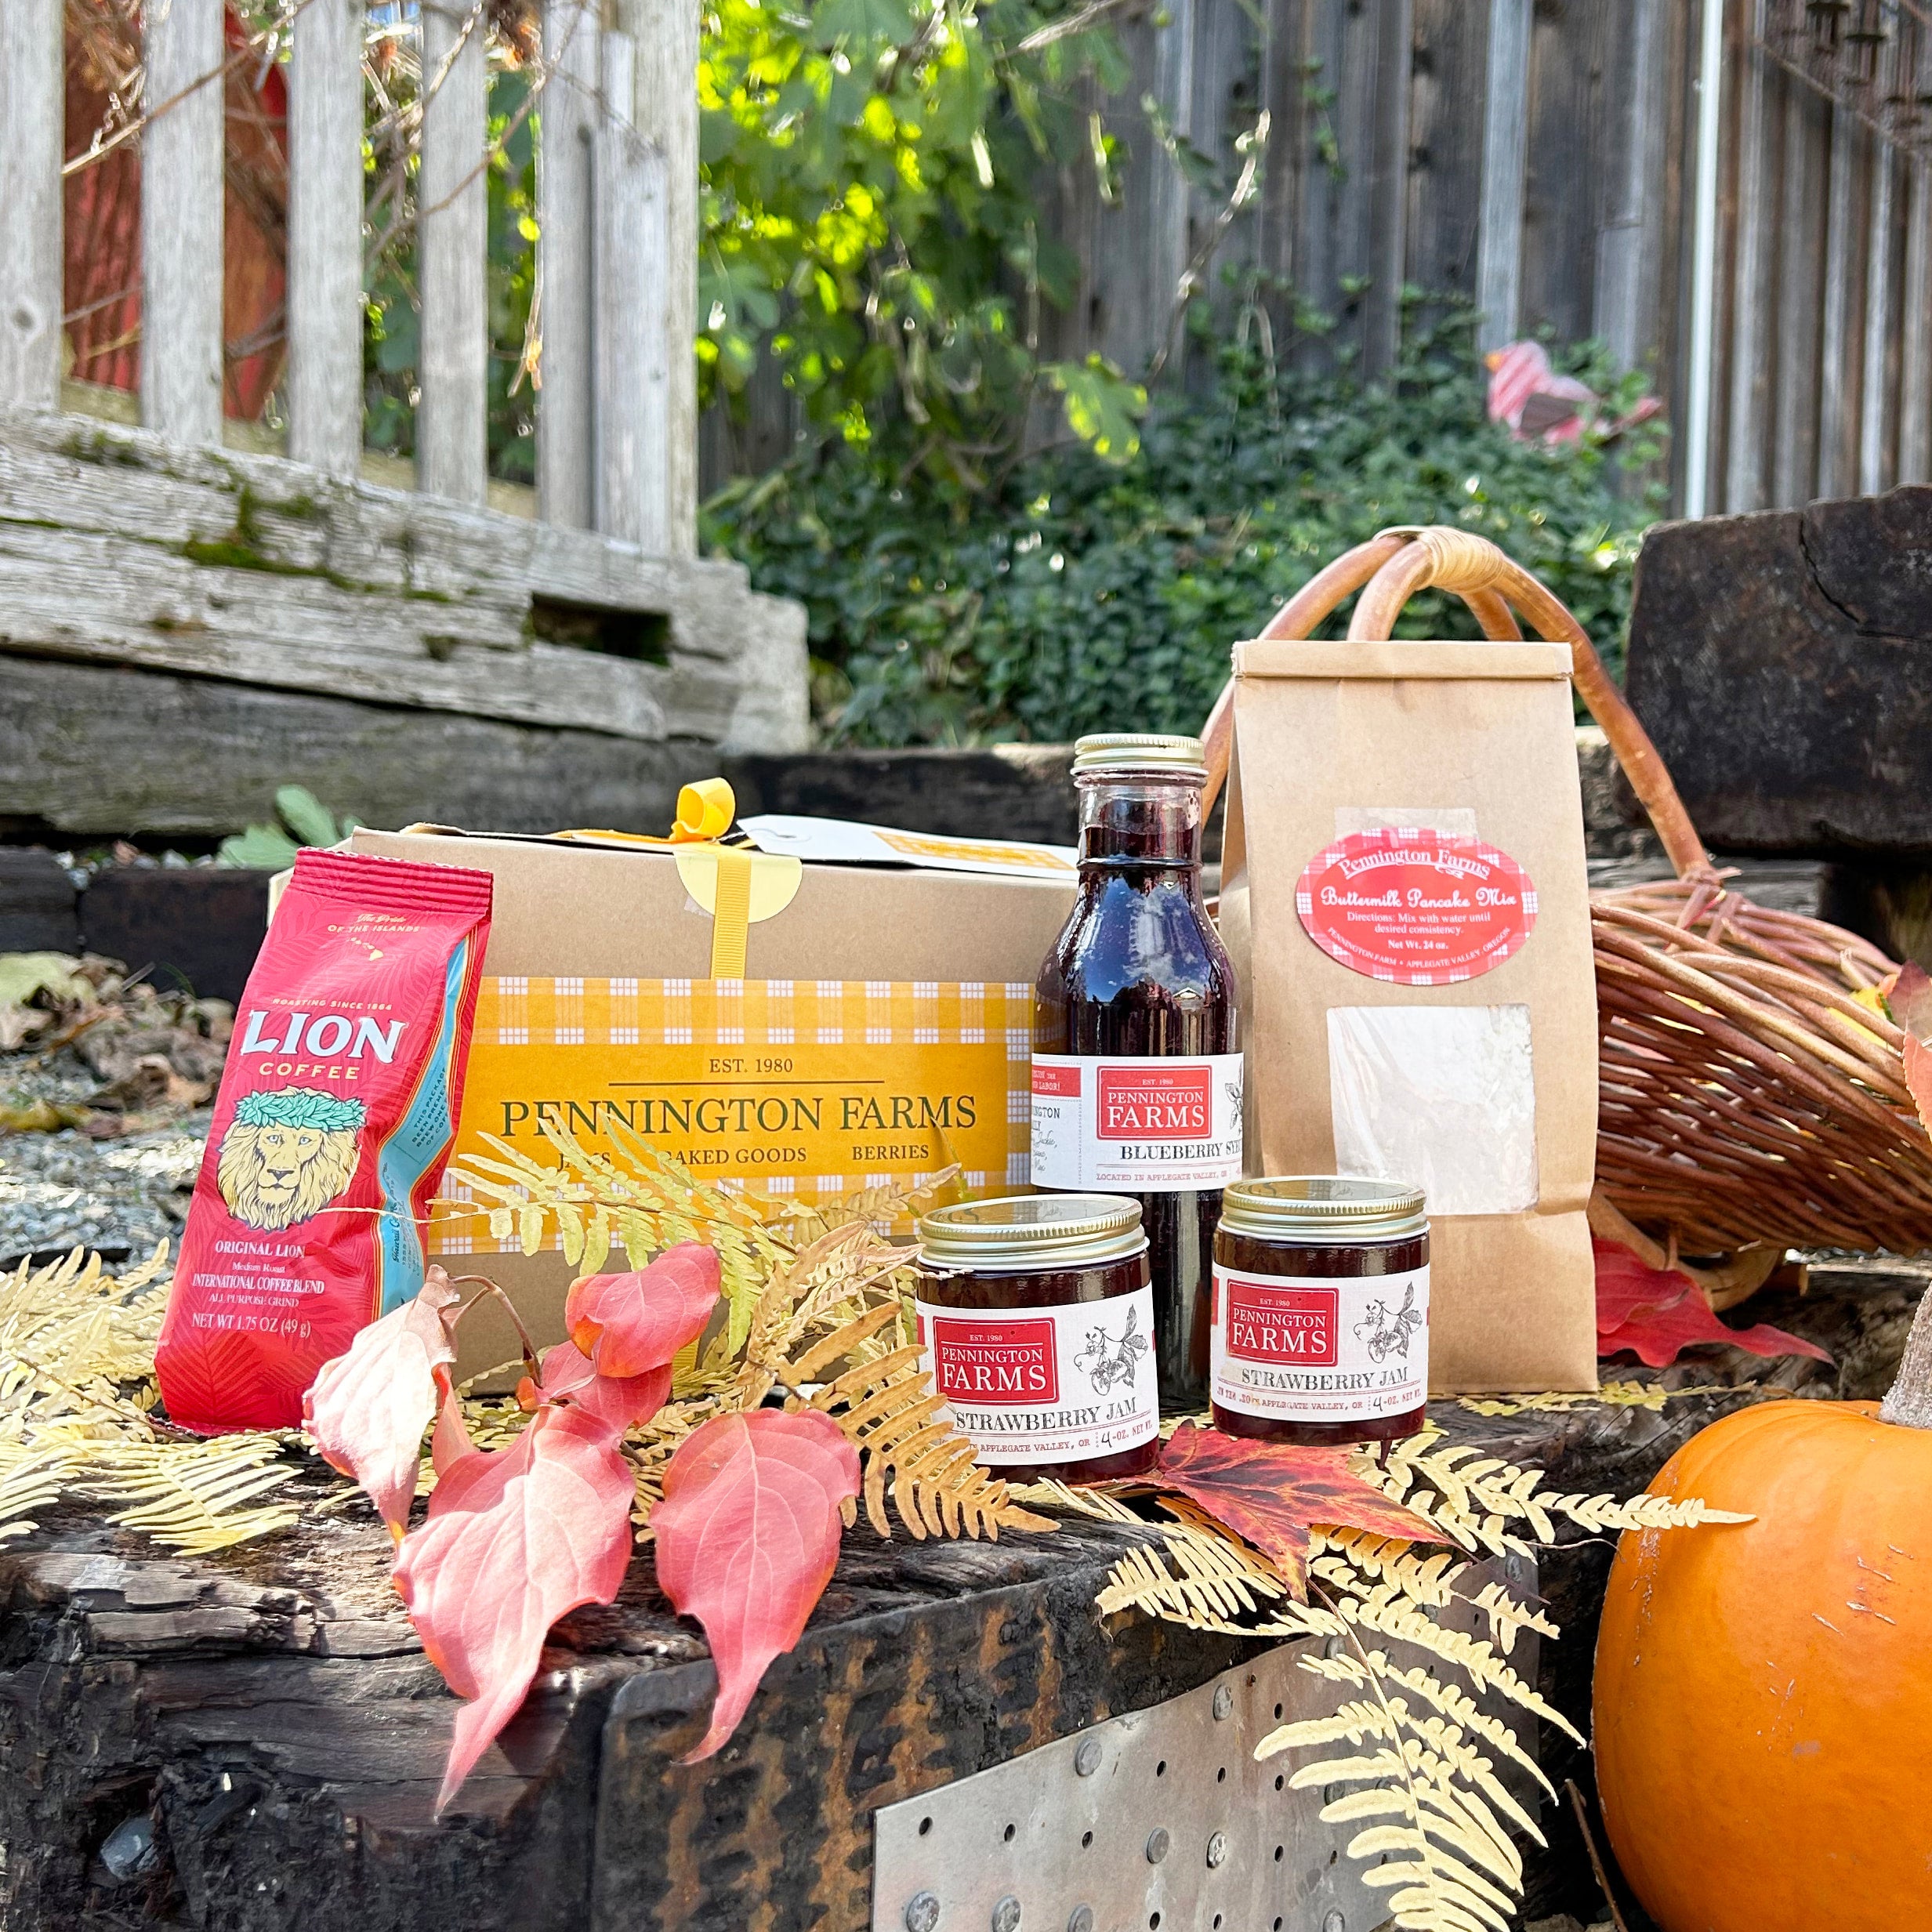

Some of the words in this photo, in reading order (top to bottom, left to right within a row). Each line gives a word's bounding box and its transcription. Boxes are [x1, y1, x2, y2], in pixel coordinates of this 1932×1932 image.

[1337, 848, 1431, 875] Pennington
[1437, 850, 1491, 877] Farms
[1321, 886, 1402, 908] Buttermilk
[1407, 887, 1470, 908] Pancake
[1475, 886, 1517, 907] Mix
[357, 913, 376, 923] The
[376, 915, 407, 924] Pride
[1347, 911, 1395, 922] Directions:
[1398, 912, 1416, 923] Mix
[1419, 912, 1439, 923] with
[1442, 914, 1466, 923] water
[1470, 911, 1491, 923] until
[328, 924, 344, 933] OF
[348, 925, 369, 933] THE
[1374, 923, 1408, 934] desired
[1409, 925, 1464, 937] consistency.
[1328, 927, 1372, 958] PENNINGTON
[1372, 954, 1397, 966] FARM
[1406, 959, 1451, 968] APPLEGATE
[1483, 926, 1511, 952] OREGON
[1387, 939, 1403, 949] Net
[1405, 939, 1421, 950] Wt.
[1423, 940, 1434, 950] 24
[1435, 941, 1448, 950] oz.
[272, 998, 326, 1007] ROASTING
[330, 1000, 363, 1009] SINCE
[241, 1009, 408, 1064] LION
[259, 1062, 361, 1080] COFFEE
[709, 1058, 748, 1074] EST.
[756, 1058, 793, 1073] 1980
[1107, 1092, 1204, 1104] PENNINGTON
[500, 1096, 823, 1136] PENNINGTON
[839, 1095, 977, 1130] FARMS
[1107, 1105, 1205, 1129] FARMS
[557, 1151, 611, 1172] JS
[663, 1149, 729, 1165] AKED
[736, 1147, 807, 1163] GOODS
[852, 1144, 929, 1160] BERRIES
[1119, 1143, 1223, 1160] BLUEBERRY
[1096, 1173, 1131, 1181] LOCATED
[215, 1240, 273, 1256] ORIGINAL
[275, 1244, 306, 1259] LION
[192, 1273, 256, 1290] INTERNATIONAL
[257, 1277, 293, 1292] COFFEE
[292, 1279, 325, 1294] BLEND
[208, 1293, 224, 1303] ALL
[227, 1294, 266, 1306] PURPOSE
[268, 1297, 299, 1307] GRIND
[191, 1312, 214, 1328] NET
[217, 1314, 234, 1329] WT
[237, 1315, 258, 1331] 1.75
[259, 1317, 278, 1332] OZ
[281, 1318, 299, 1337] (49
[299, 1320, 312, 1339] g)
[1233, 1308, 1325, 1328] PENNINGTON
[1232, 1321, 1327, 1354] FARMS
[942, 1347, 1043, 1363] PENNINGTON
[942, 1363, 1046, 1391] FARMS
[1241, 1368, 1376, 1390] STRAWBERRY
[1379, 1366, 1408, 1386] JAM
[956, 1405, 1101, 1431] STRAWBERRY
[1106, 1397, 1137, 1420] JAM
[1262, 1399, 1308, 1410] APPLEGATE
[1311, 1402, 1348, 1411] VALLEY,
[980, 1444, 1031, 1452] APPLEGATE
[1034, 1441, 1075, 1451] VALLEY,
